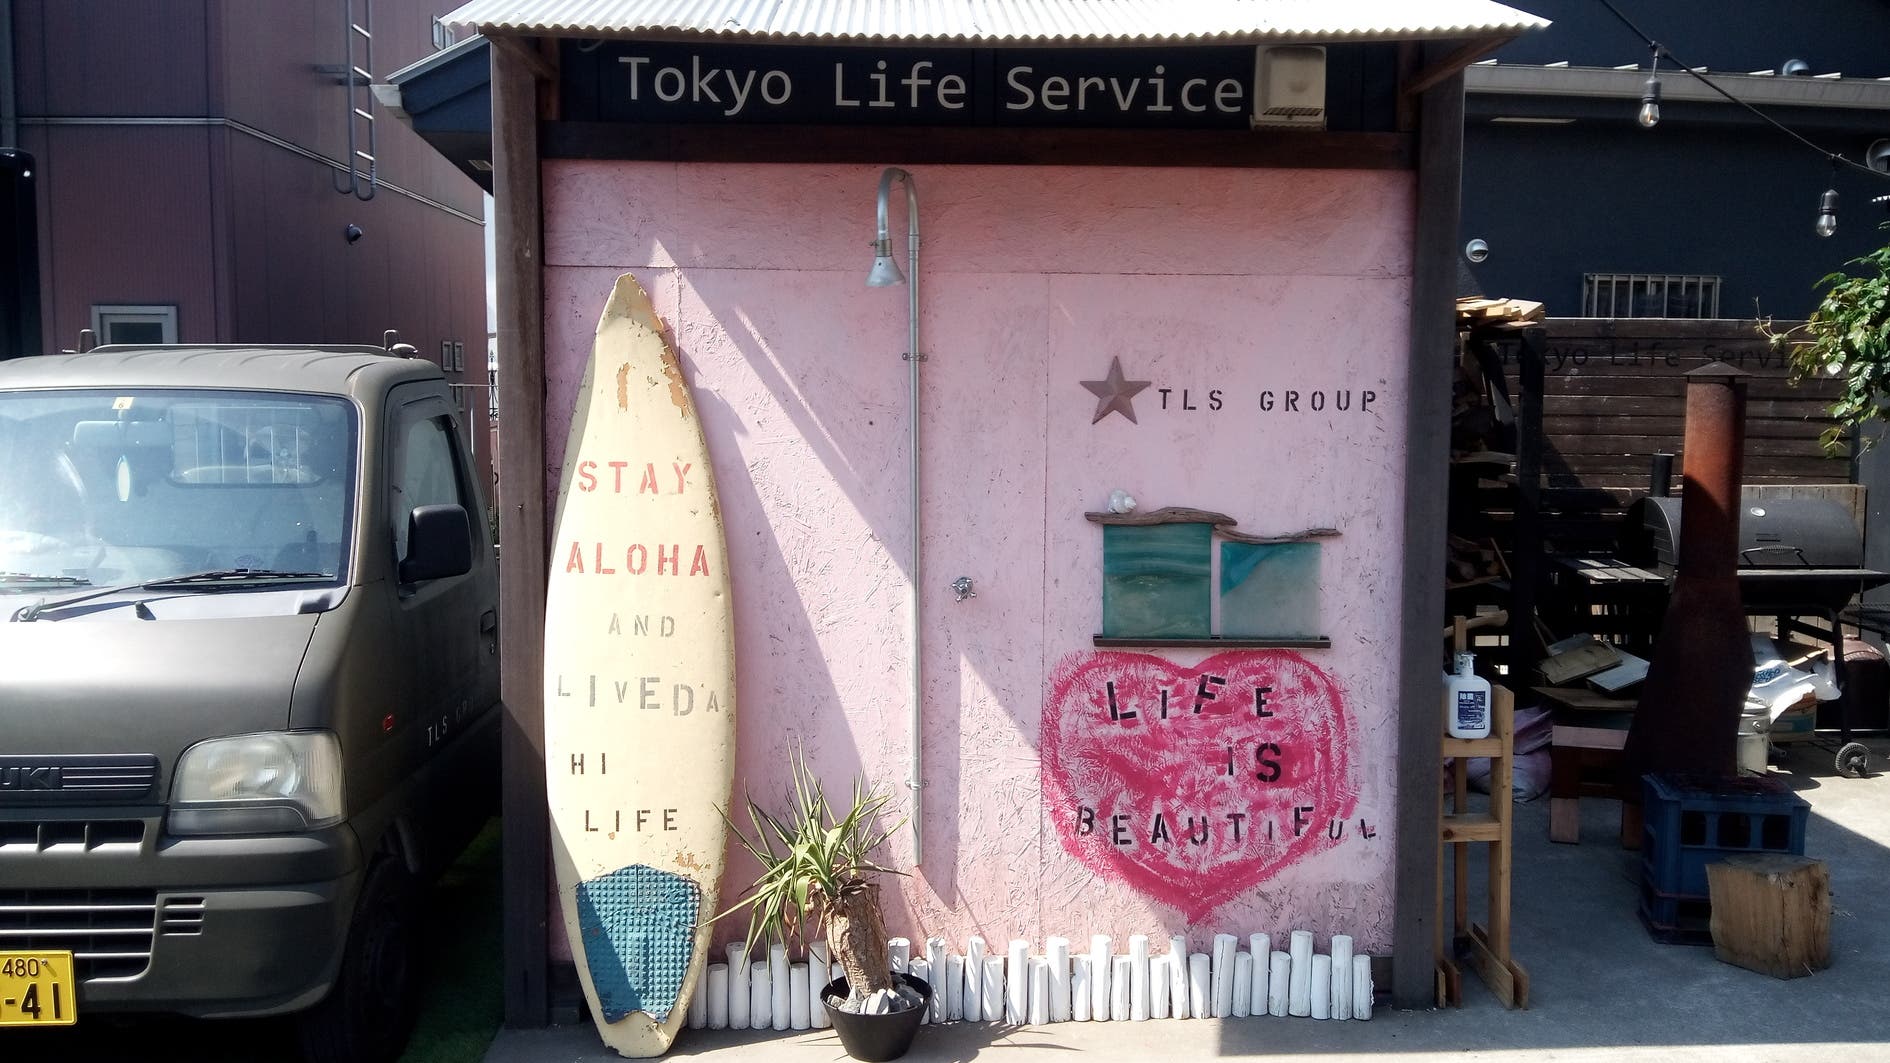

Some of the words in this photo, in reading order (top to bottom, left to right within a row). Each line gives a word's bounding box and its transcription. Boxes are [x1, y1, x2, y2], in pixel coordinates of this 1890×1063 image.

[618, 56, 792, 116] Tokyo
[835, 60, 967, 110] Life
[1006, 65, 1244, 113] Service
[1611, 342, 1680, 368] Life
[1158, 389, 1223, 411] TLS
[1259, 390, 1376, 412] GROUP
[578, 461, 692, 495] STAY
[566, 541, 710, 577] ALOHA
[608, 612, 676, 638] AND
[1106, 674, 1273, 721] LIFE
[427, 715, 448, 747] TLS
[571, 753, 606, 775] HI
[1228, 743, 1282, 782] IS
[585, 808, 678, 832] LIFE
[1075, 806, 1376, 846] BEAUTIFUL
[2, 958, 39, 977] 480
